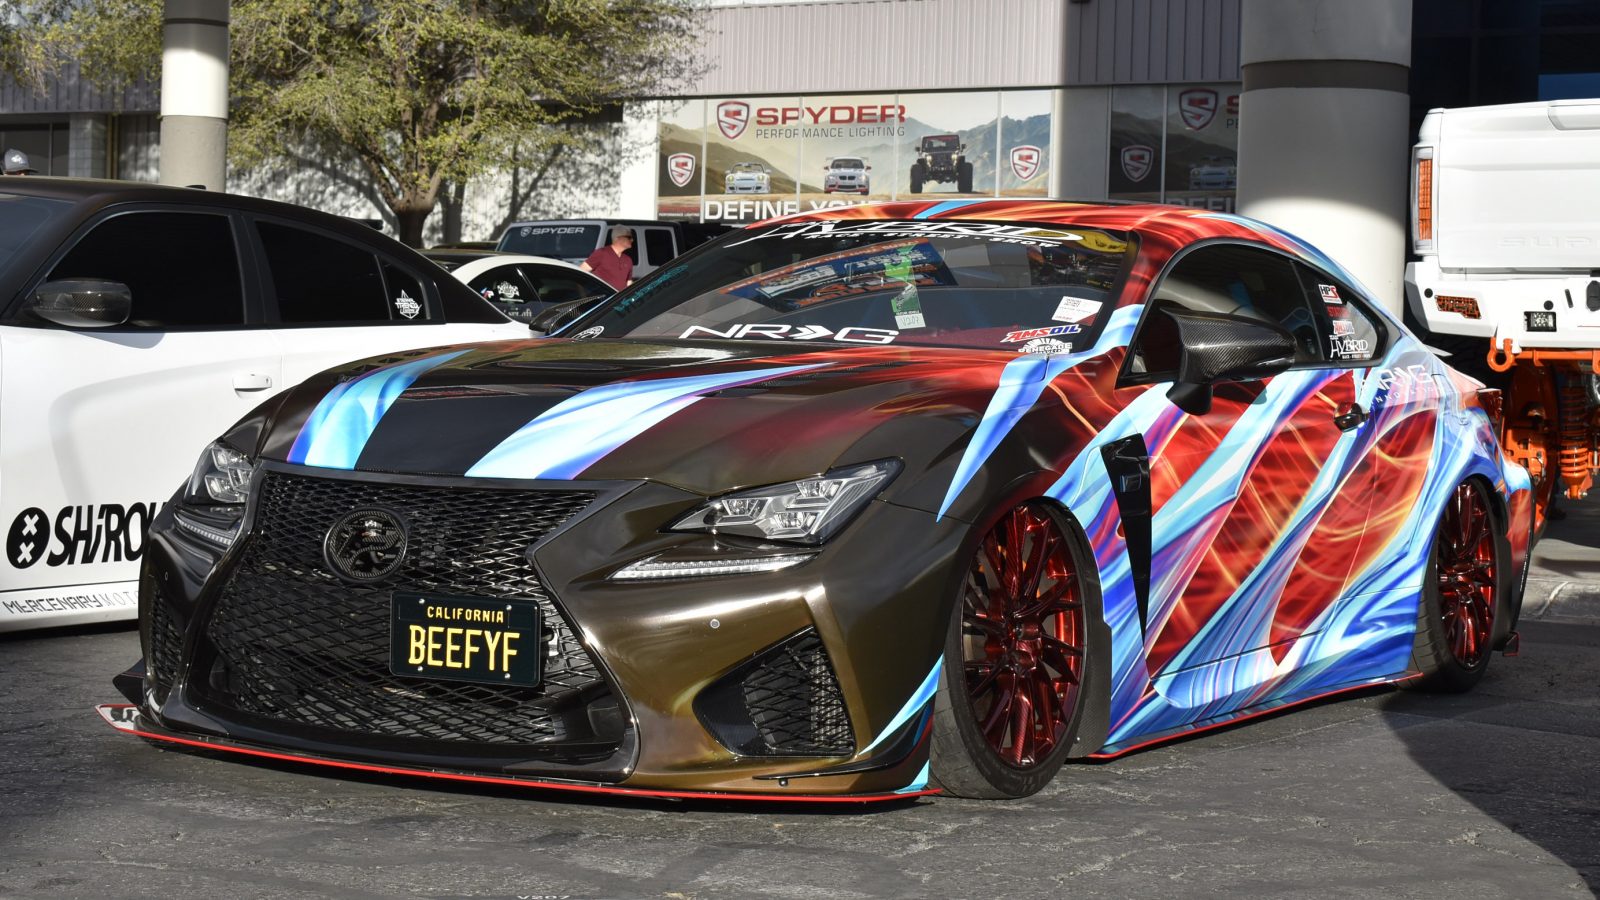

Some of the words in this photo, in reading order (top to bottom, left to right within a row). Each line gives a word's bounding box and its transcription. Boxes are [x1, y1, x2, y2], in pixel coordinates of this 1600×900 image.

[755, 105, 907, 126] SPYDER
[849, 126, 906, 138] LIGHTING
[704, 200, 799, 220] DEFINE
[532, 226, 585, 235] SPYDER
[988, 237, 1061, 248] SHOW
[1000, 324, 1082, 343] AMSOIL
[2, 594, 102, 614] MERCENARY
[427, 606, 504, 624] CALIFORNIA
[408, 625, 520, 672] BEEFYF
